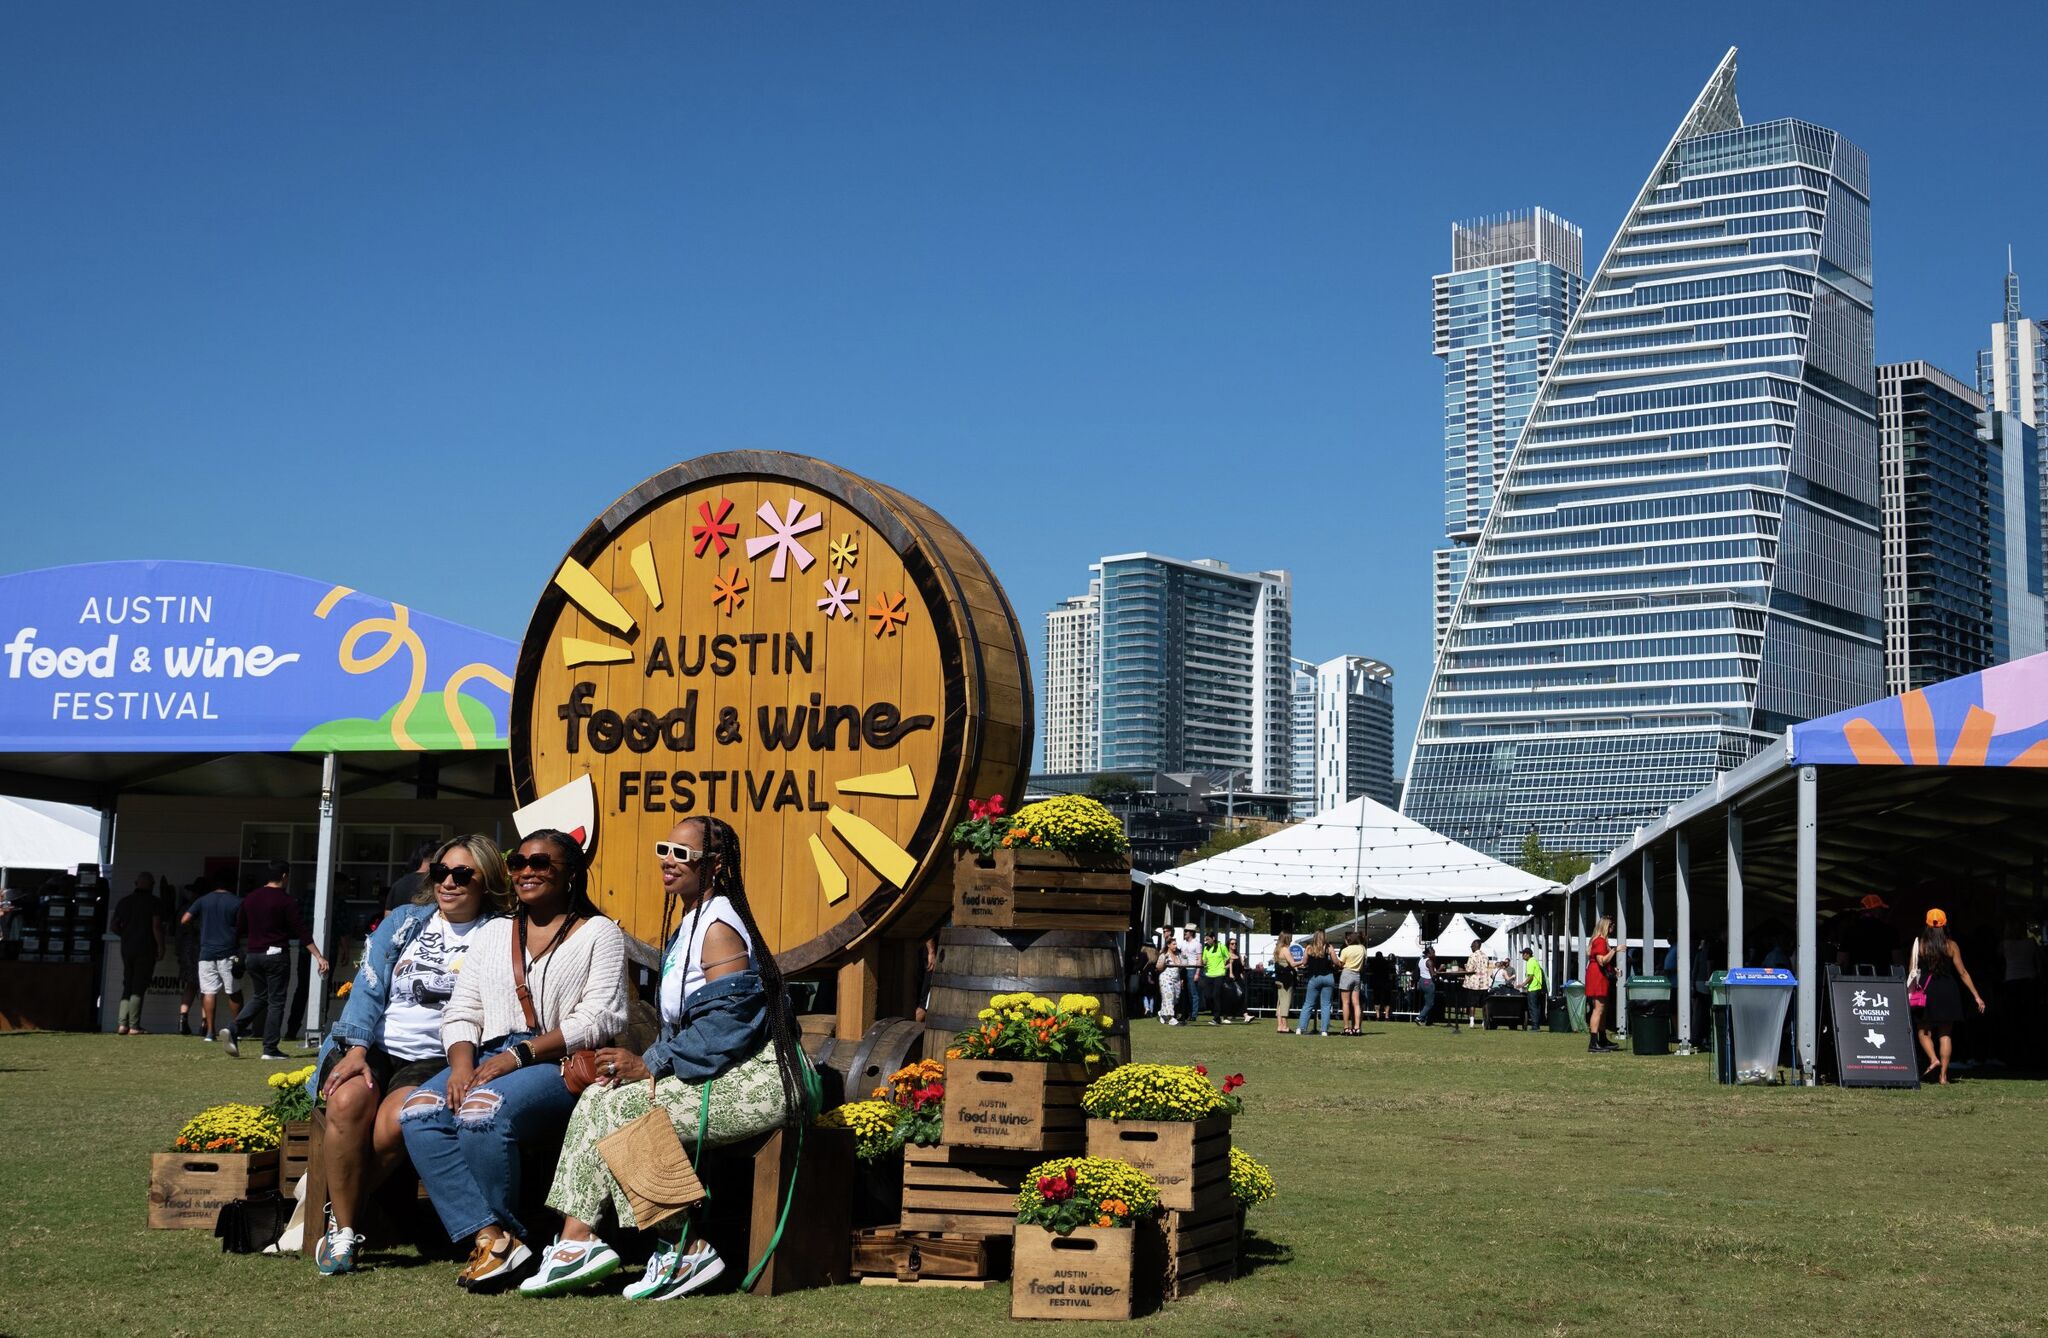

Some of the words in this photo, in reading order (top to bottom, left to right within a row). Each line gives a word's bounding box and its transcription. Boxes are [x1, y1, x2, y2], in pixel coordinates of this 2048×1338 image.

[79, 595, 212, 624] AUSTIN
[4, 627, 118, 679] food
[130, 646, 151, 674] &
[164, 637, 300, 679] wine
[644, 631, 813, 678] AUSTIN
[52, 691, 219, 720] FESTIVAL
[557, 682, 698, 754] food
[715, 706, 742, 746] &
[757, 692, 935, 752] wine
[618, 769, 830, 813] FESTIVAL
[961, 891, 981, 905] food
[986, 896, 1008, 905] wine
[1852, 1008, 1890, 1016] CANGSHAN
[978, 1100, 1007, 1109] AUSTIN
[958, 1107, 988, 1123] food
[990, 1114, 997, 1122] &
[999, 1113, 1034, 1126] wine
[973, 1126, 1010, 1136] FESTIVAL
[1130, 1160, 1155, 1169] USTIN
[162, 1195, 192, 1209] food
[194, 1200, 201, 1208] &
[178, 1211, 213, 1219] FESTIVAL
[1054, 1270, 1088, 1279] AUSTIN
[1029, 1278, 1065, 1295] food
[1068, 1284, 1077, 1294] &
[1079, 1283, 1121, 1296] wine
[1049, 1298, 1092, 1307] FESTIVAL
